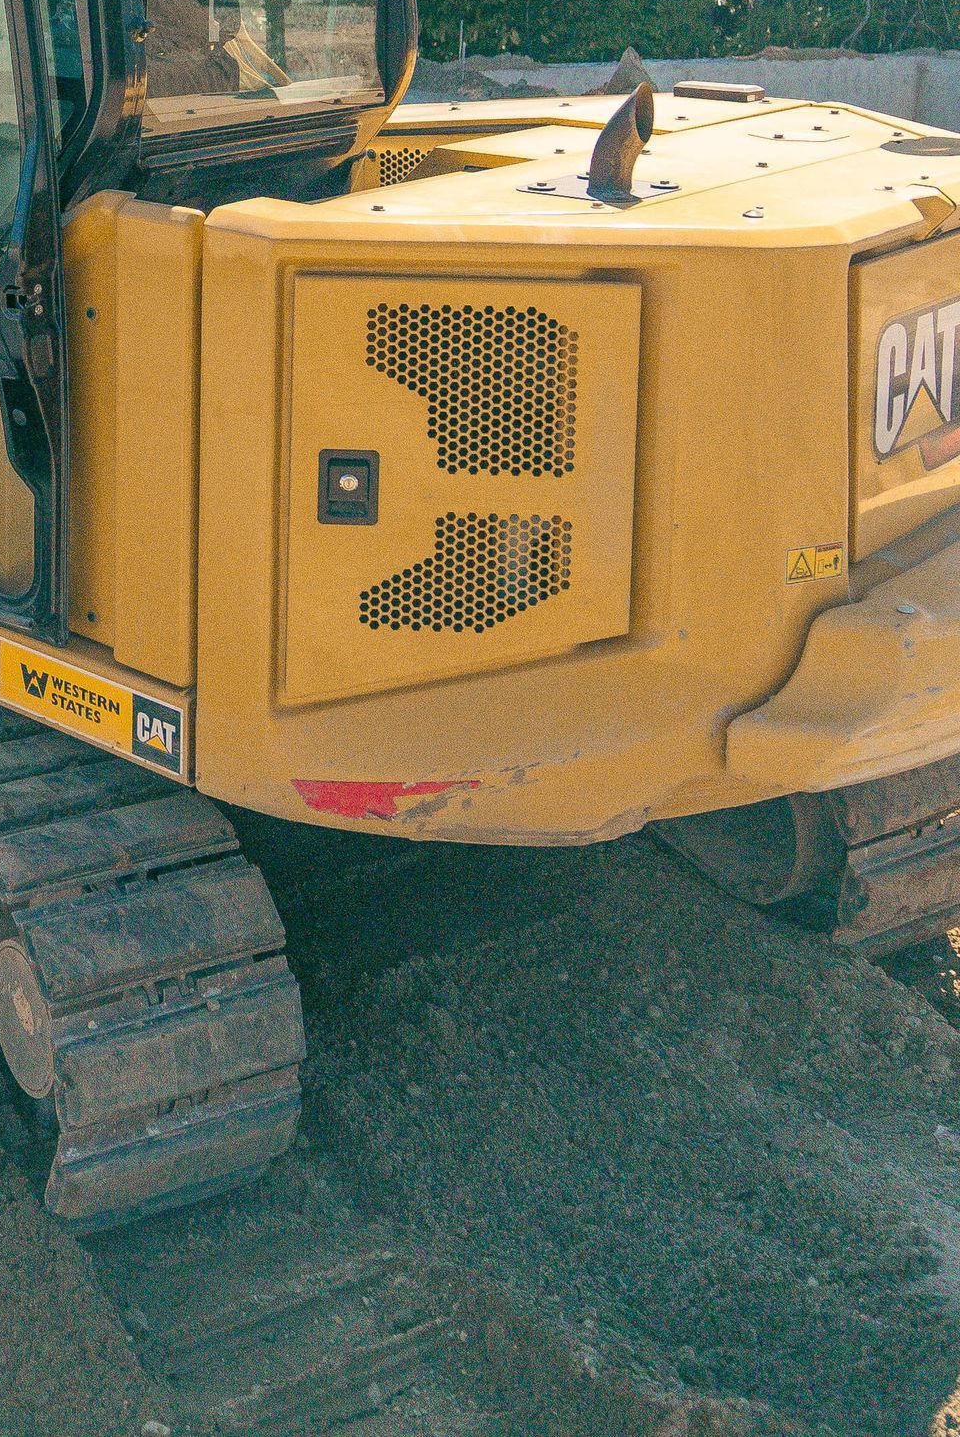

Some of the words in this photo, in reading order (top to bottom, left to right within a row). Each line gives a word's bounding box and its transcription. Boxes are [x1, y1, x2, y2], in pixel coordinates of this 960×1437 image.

[875, 300, 960, 454] CAT
[51, 675, 121, 716] WESTERN
[51, 693, 102, 724] STATES
[136, 711, 176, 755] CAT
